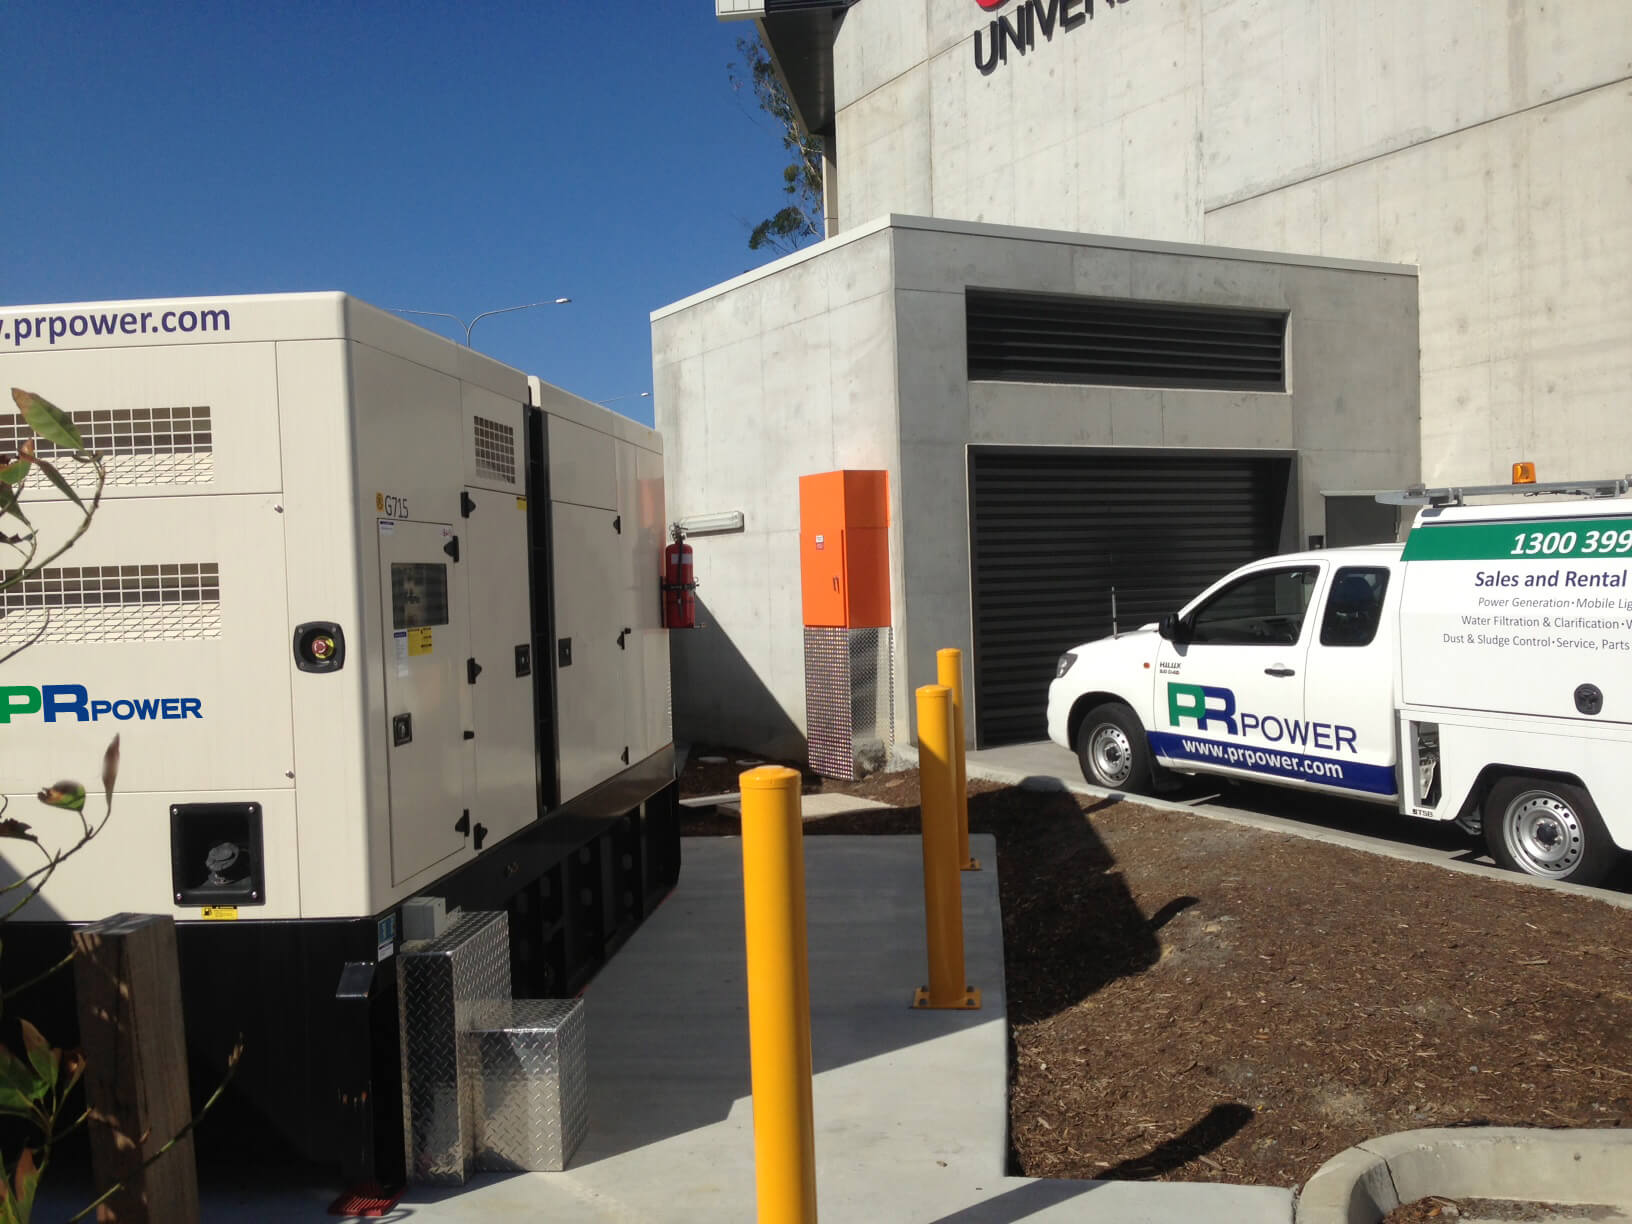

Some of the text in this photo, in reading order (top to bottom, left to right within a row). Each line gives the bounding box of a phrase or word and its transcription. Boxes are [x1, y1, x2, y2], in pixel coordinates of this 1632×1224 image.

[974, 0, 1131, 77] UNIVE
[0, 308, 231, 346] .prpower.com
[384, 495, 409, 519] G715
[1510, 530, 1632, 555] 1300 399
[1475, 569, 1628, 587] Sales and Rental
[1478, 597, 1510, 607] Power
[1512, 597, 1570, 608] Generation
[1576, 598, 1615, 609] Mobile
[1461, 615, 1491, 626] Water
[1494, 616, 1540, 627] Filtration
[1543, 617, 1551, 628] &
[1554, 617, 1620, 630] Clarification
[1443, 633, 1631, 651] Dust & Sludge Control Service, Parts
[1182, 738, 1344, 779] www.prpower.com
